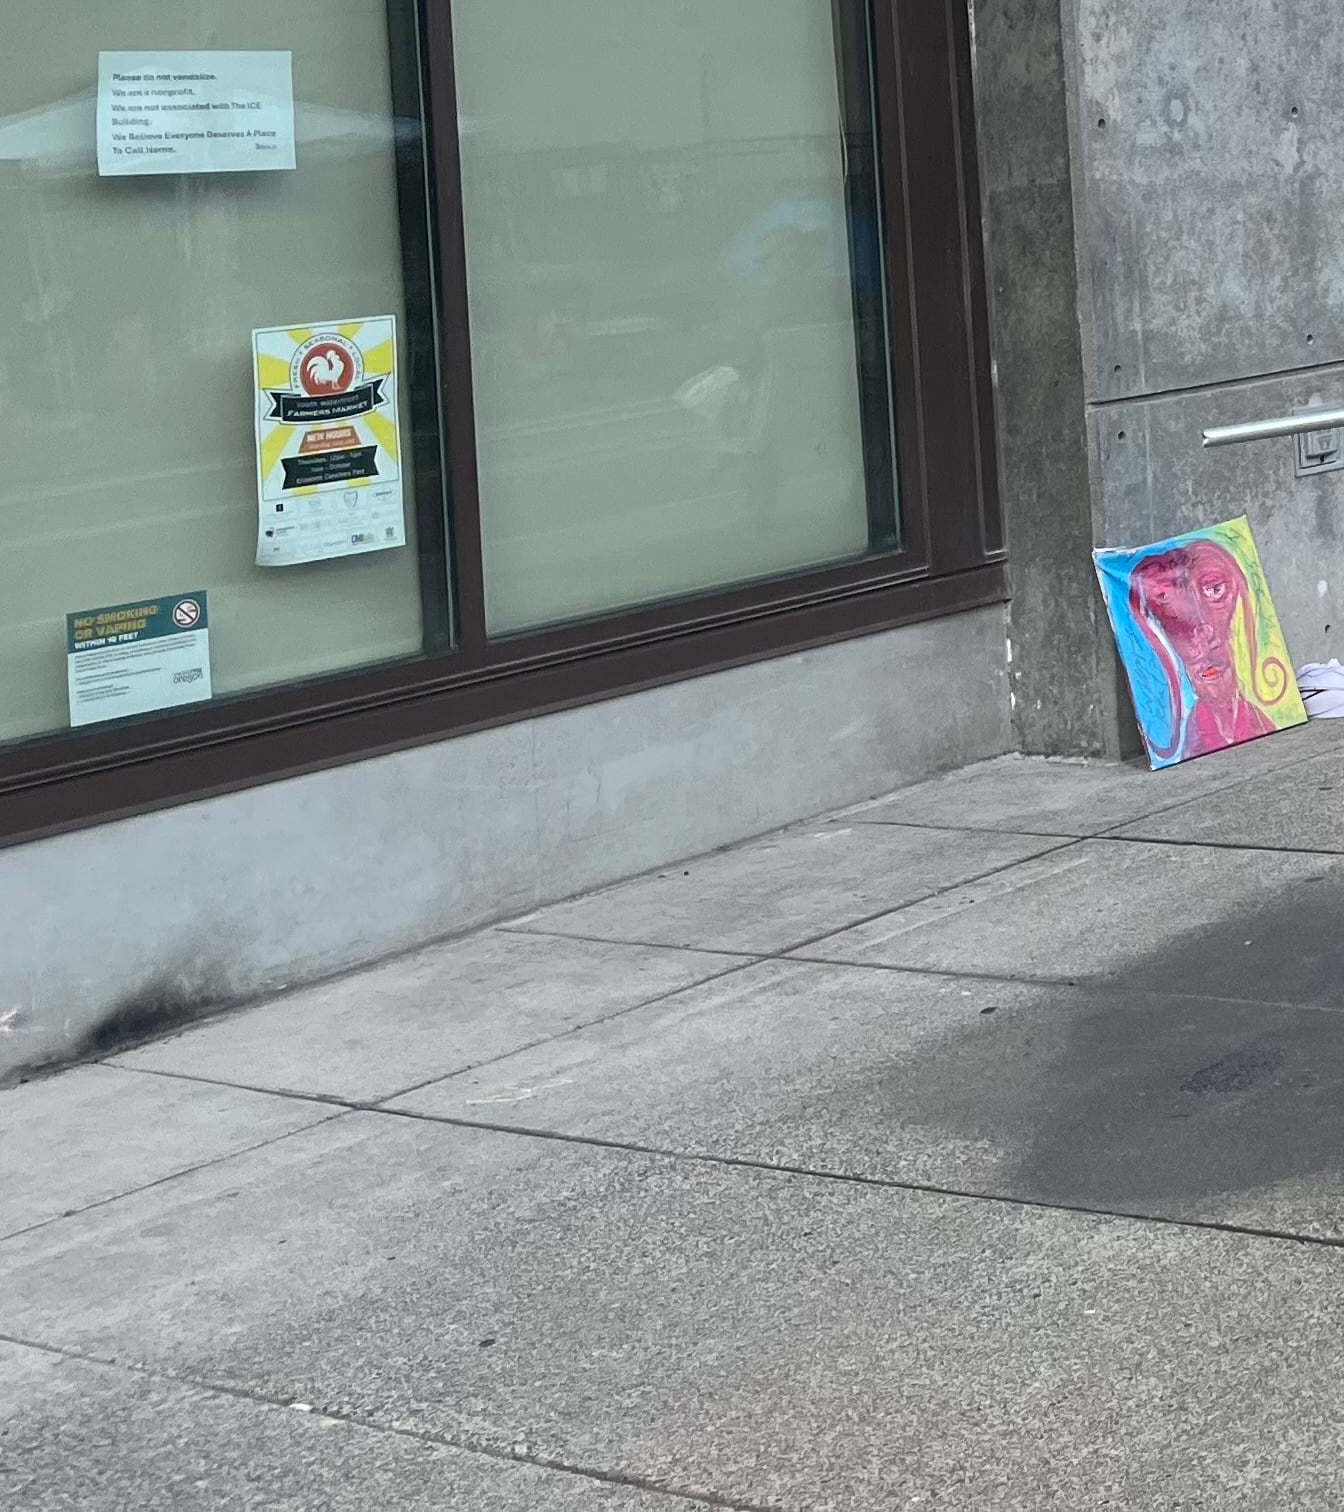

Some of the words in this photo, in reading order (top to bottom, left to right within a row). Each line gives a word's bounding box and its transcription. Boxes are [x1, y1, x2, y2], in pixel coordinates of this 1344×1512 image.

[74, 616, 92, 628] NO
[96, 605, 158, 625] SMOKING
[74, 628, 93, 640] OR
[96, 618, 146, 637] VAPING
[74, 637, 106, 650] WITHIN
[118, 631, 139, 642] FEET
